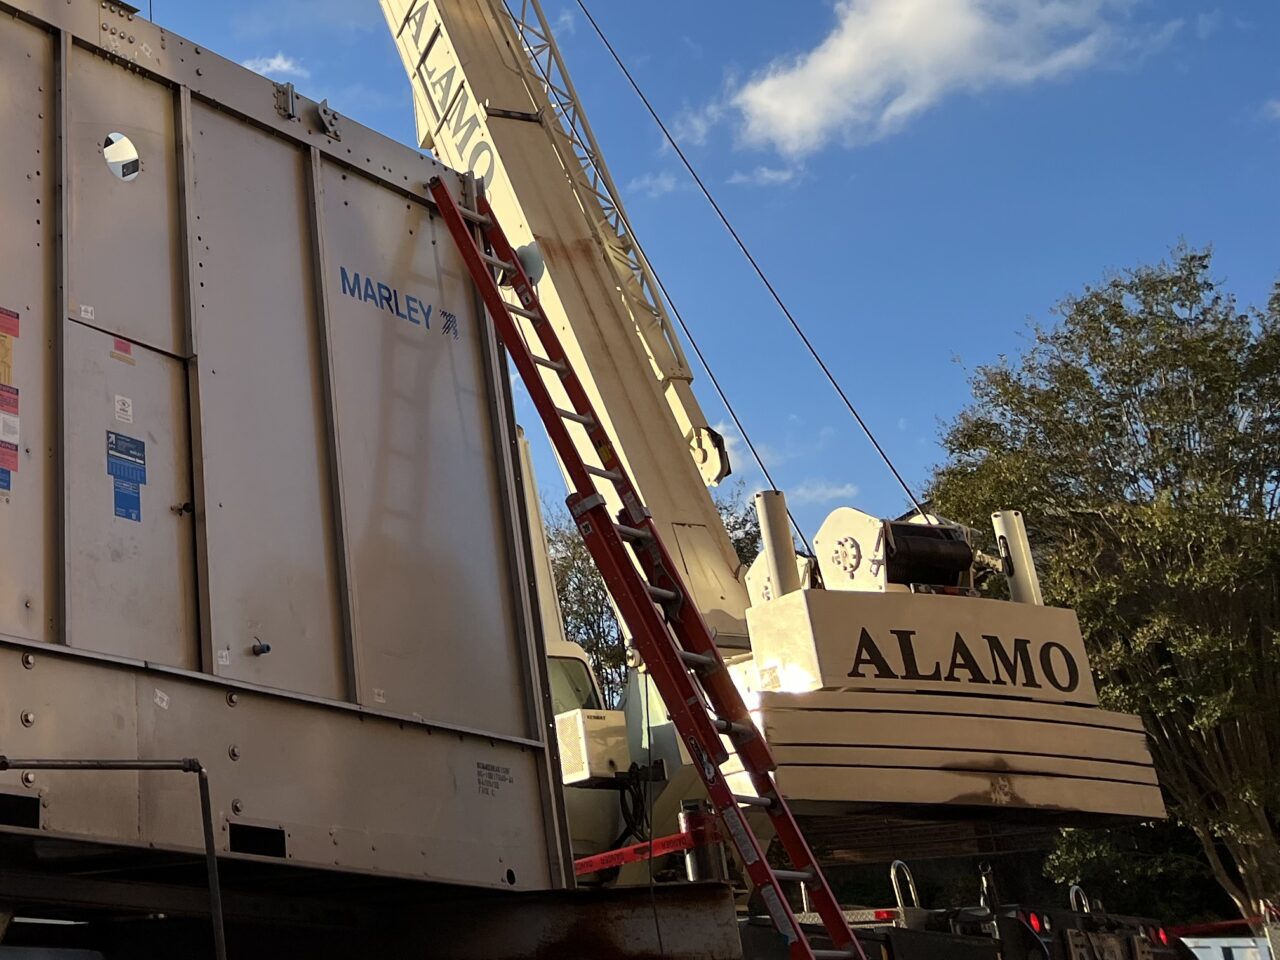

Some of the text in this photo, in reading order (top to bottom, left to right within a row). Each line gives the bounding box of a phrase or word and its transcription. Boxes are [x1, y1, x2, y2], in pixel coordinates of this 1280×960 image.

[406, 0, 495, 188] ALAMO
[339, 266, 432, 330] MARLEY
[847, 626, 1080, 693] ALAMO
